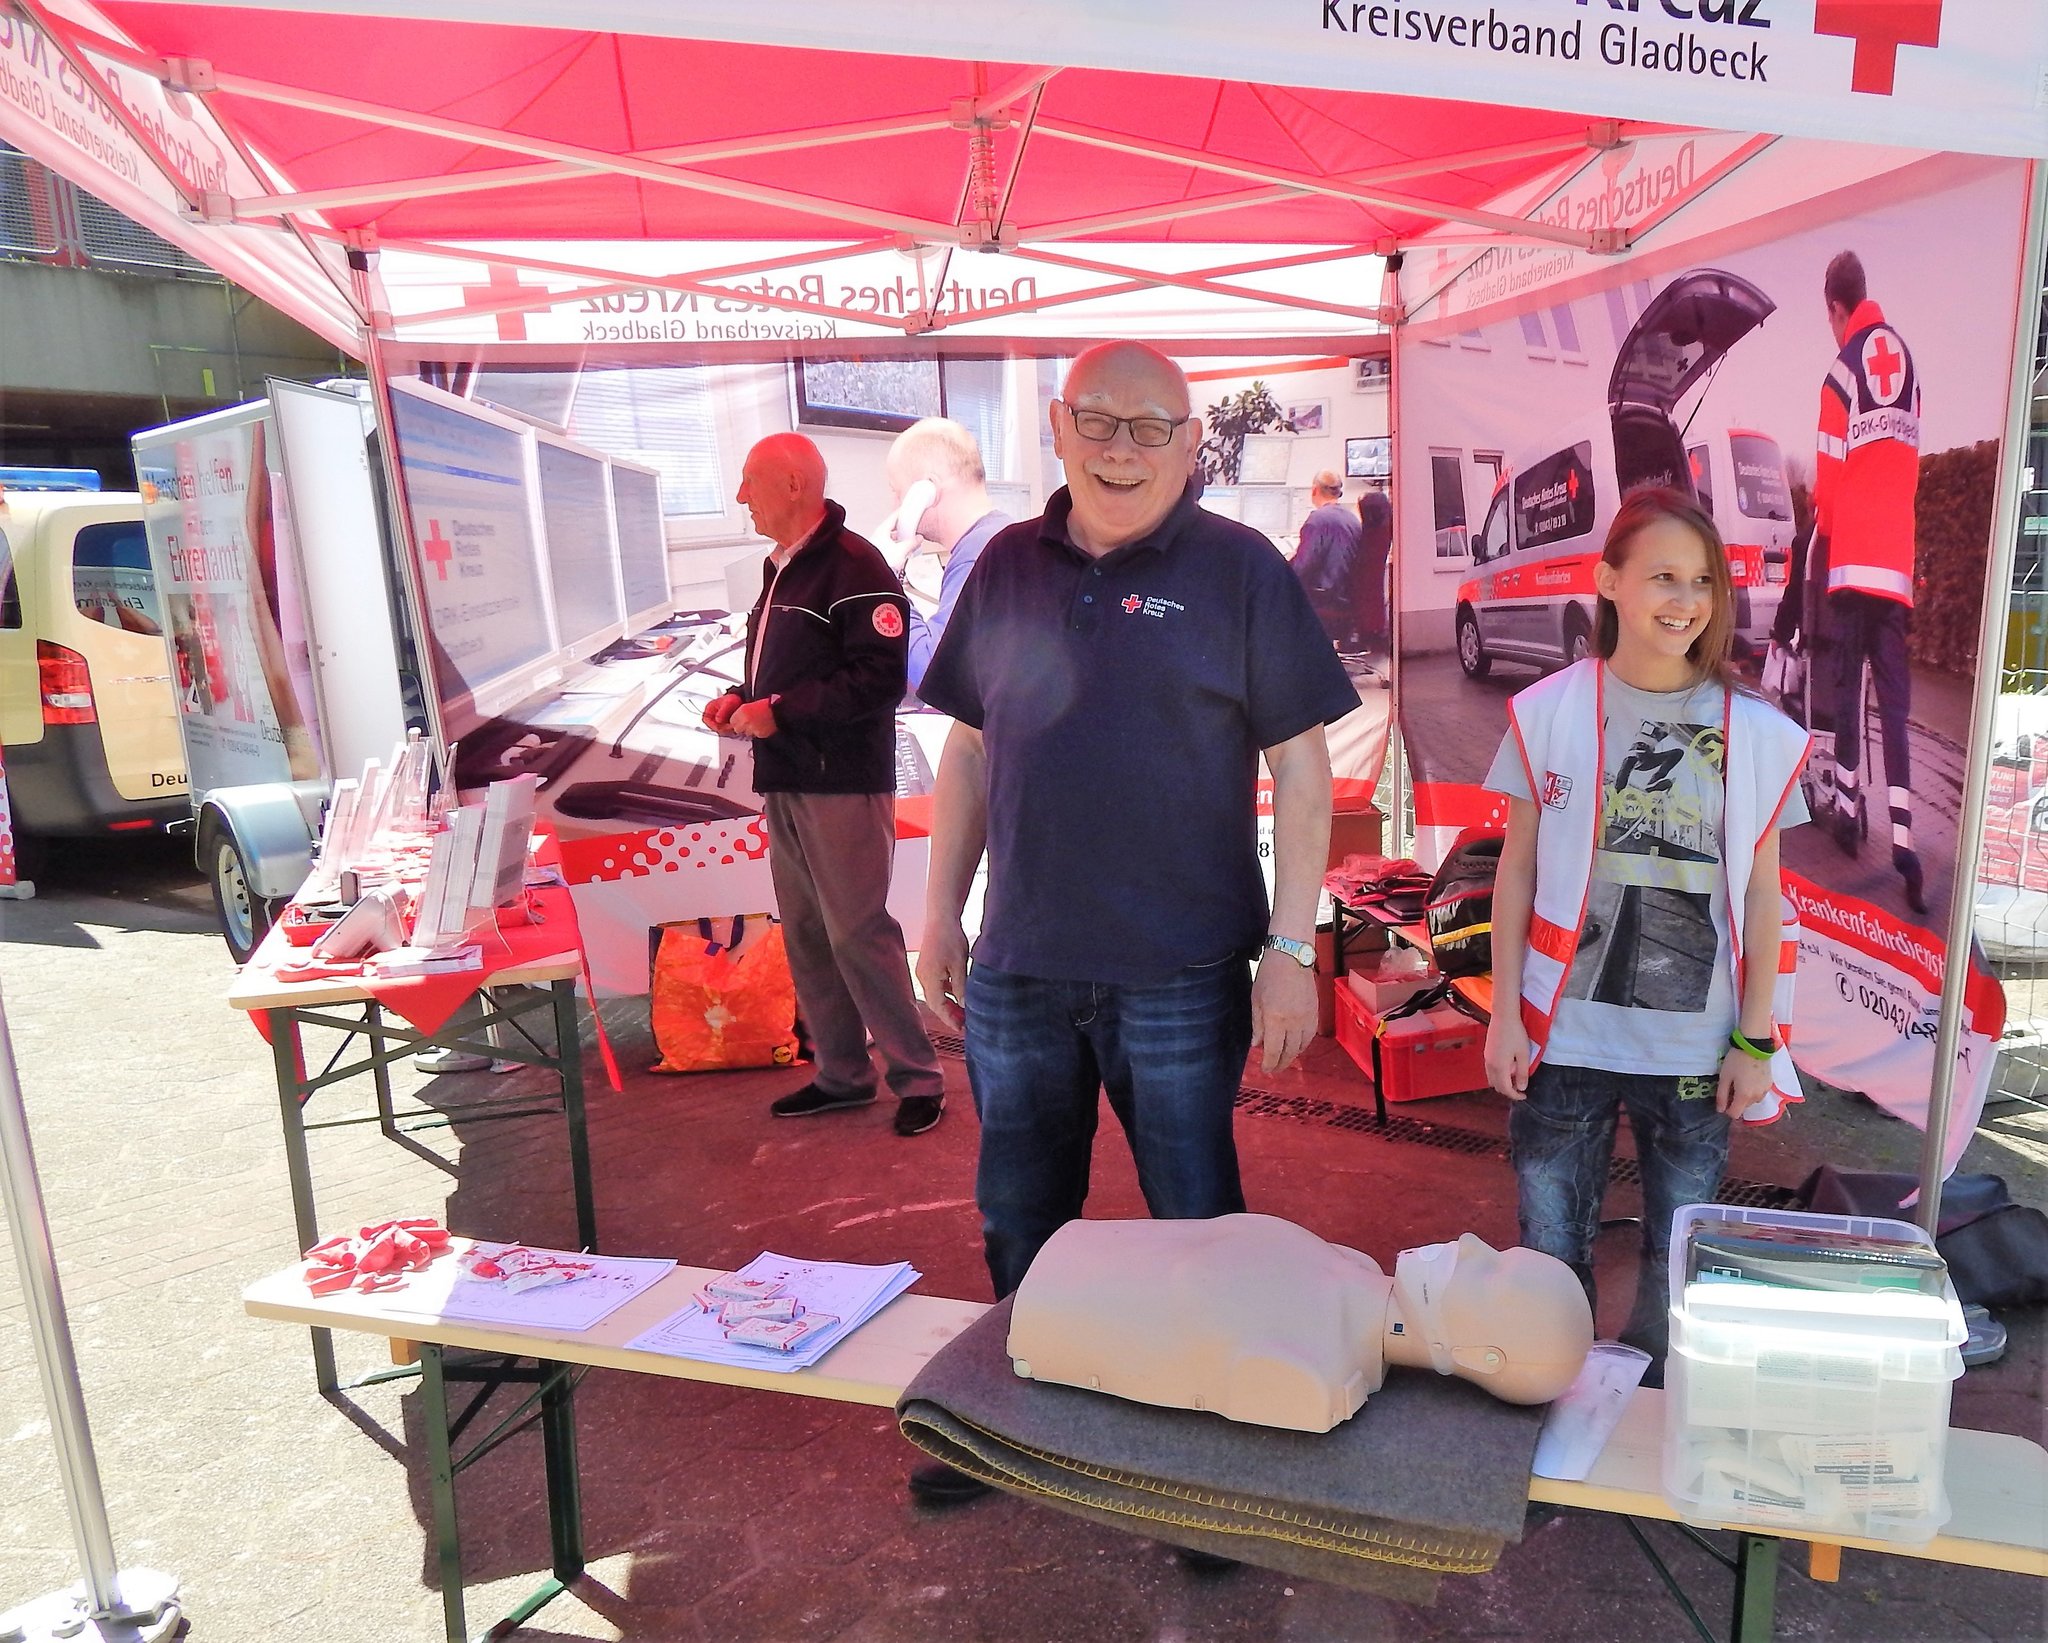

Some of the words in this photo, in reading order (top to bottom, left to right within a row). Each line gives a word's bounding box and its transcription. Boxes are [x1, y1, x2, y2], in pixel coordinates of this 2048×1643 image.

[1321, 0, 1581, 61] Kreisverband
[1600, 23, 1768, 83] Gladbeck
[167, 535, 242, 582] Ehrenamt
[1144, 602, 1166, 612] Rotes
[1147, 596, 1185, 611] Deutsches
[1143, 608, 1164, 618] Kreuz
[151, 772, 188, 788] Deu
[1788, 883, 1945, 981] Krankenfahrdienst
